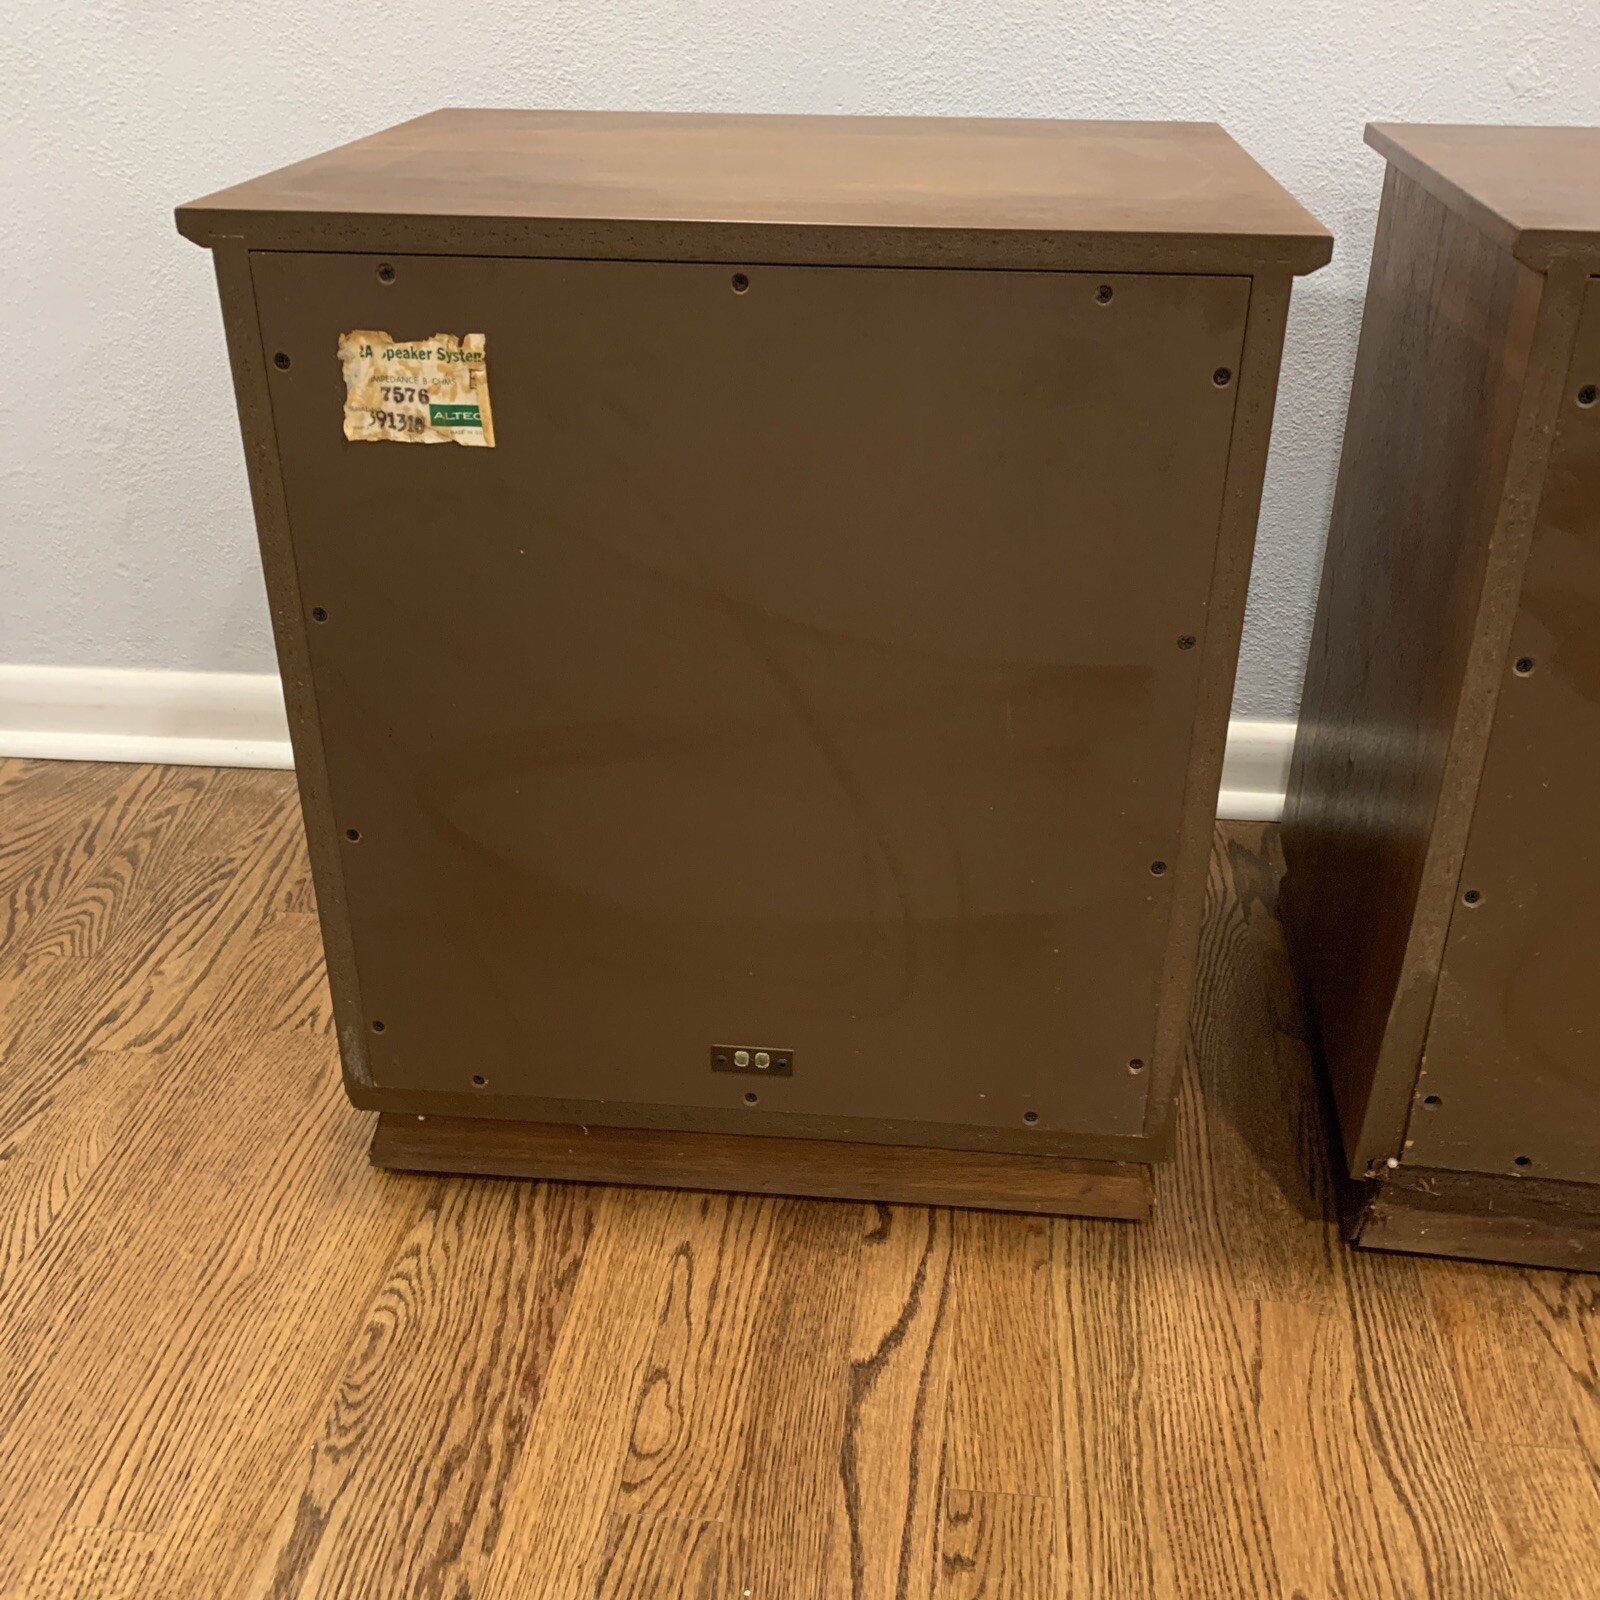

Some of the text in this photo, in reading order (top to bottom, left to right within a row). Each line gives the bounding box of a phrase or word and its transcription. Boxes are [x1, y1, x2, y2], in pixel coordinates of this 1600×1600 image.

[382, 346, 432, 361] peaker
[380, 386, 430, 404] 7576
[433, 411, 481, 421] ALTEC
